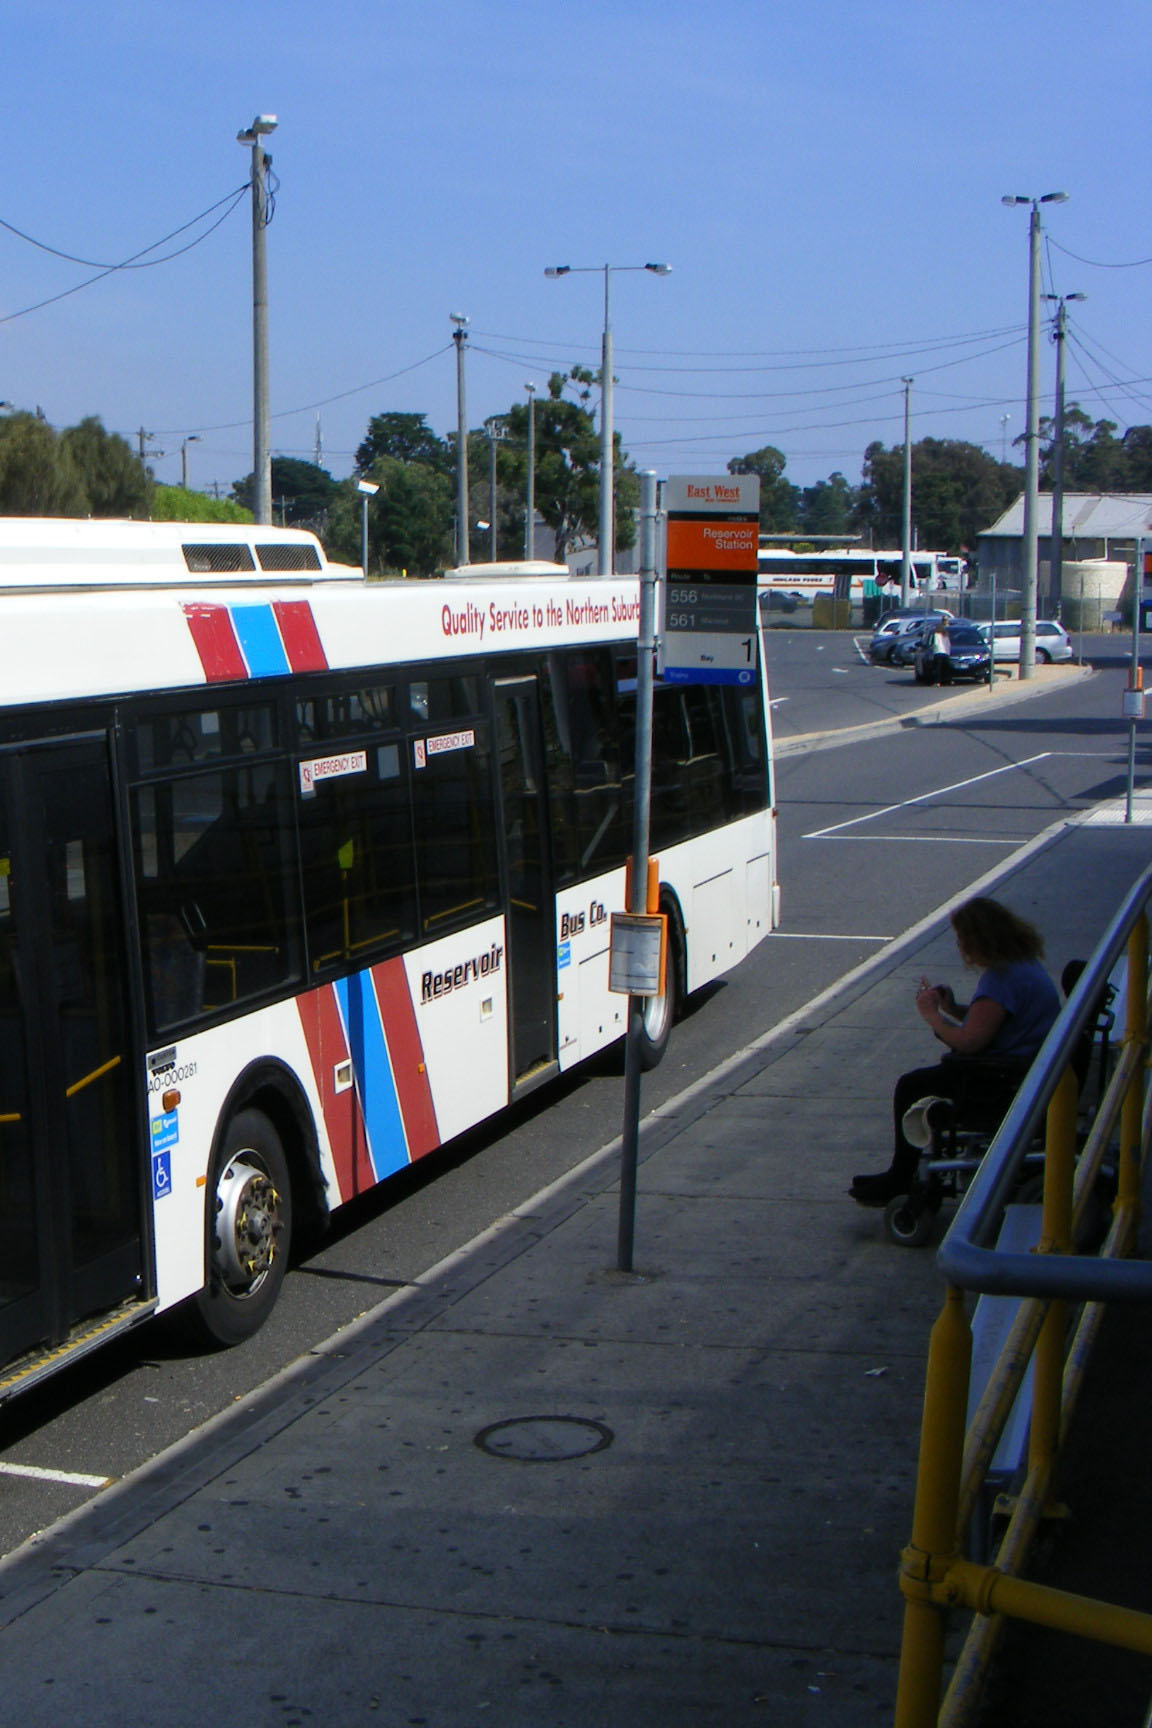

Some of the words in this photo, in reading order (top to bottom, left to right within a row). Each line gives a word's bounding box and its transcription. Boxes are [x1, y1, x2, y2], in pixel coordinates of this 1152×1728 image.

[687, 485, 710, 497] East
[714, 485, 740, 498] West
[703, 528, 753, 538] Reservoir
[715, 539, 752, 549] Station
[670, 590, 697, 603] 556
[442, 602, 485, 640] Quality
[489, 602, 528, 632] Service
[532, 604, 543, 627] to
[547, 599, 562, 626] the
[566, 596, 609, 625] Northern
[612, 594, 640, 622] Suburb
[669, 614, 695, 627] 561
[741, 638, 751, 662] 1
[700, 655, 714, 663] Bay
[428, 734, 460, 753] EMERGENCY
[461, 731, 473, 746] EXIT
[314, 757, 349, 777] EMERGENCY
[351, 754, 364, 768] EXIT
[420, 943, 504, 1005] Reservoir
[560, 911, 585, 942] Bus
[589, 900, 607, 928] Co.
